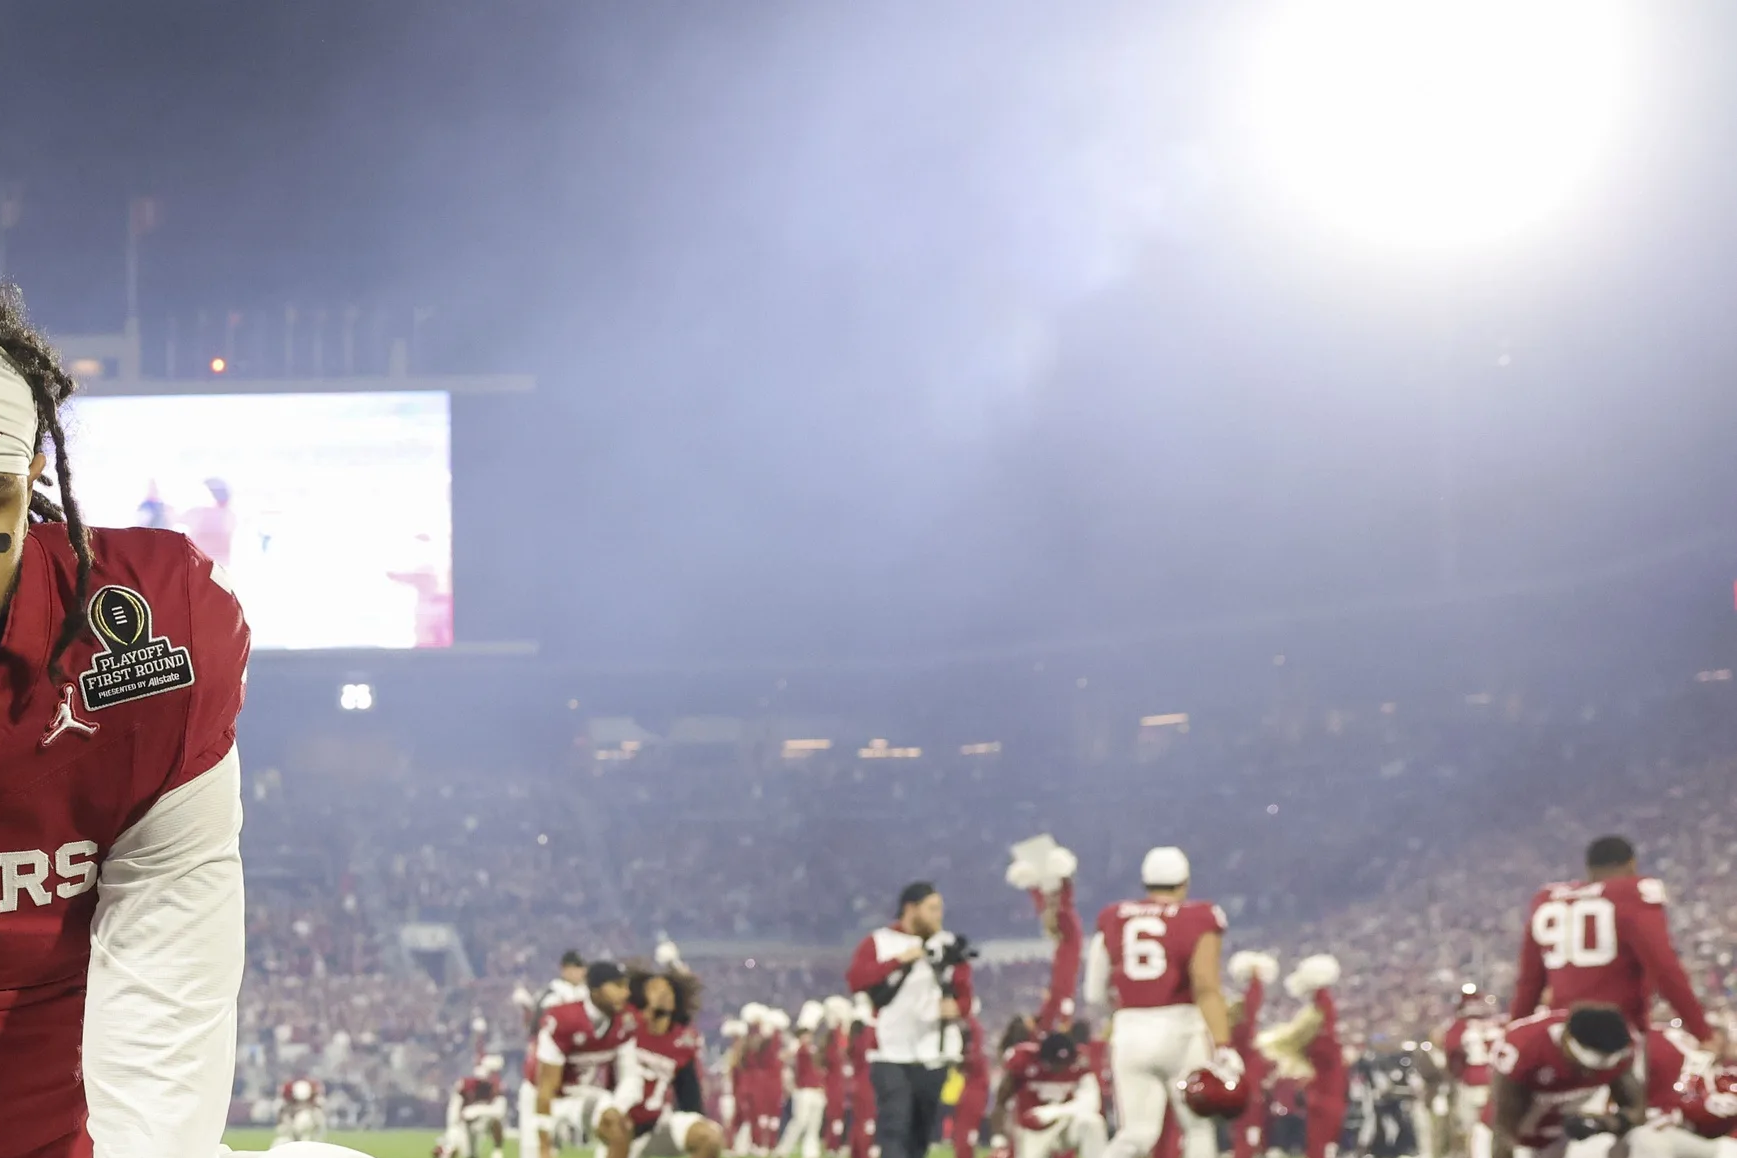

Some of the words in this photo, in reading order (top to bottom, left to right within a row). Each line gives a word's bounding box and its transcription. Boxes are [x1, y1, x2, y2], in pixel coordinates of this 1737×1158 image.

[86, 667, 132, 691] FIRST
[135, 653, 185, 678] ROUND
[99, 643, 165, 672] PLAYOFF
[98, 683, 137, 699] PRESENTED
[137, 680, 147, 689] BY
[147, 671, 180, 688] Allstate
[1122, 915, 1168, 981] 6
[1531, 899, 1618, 969] 90
